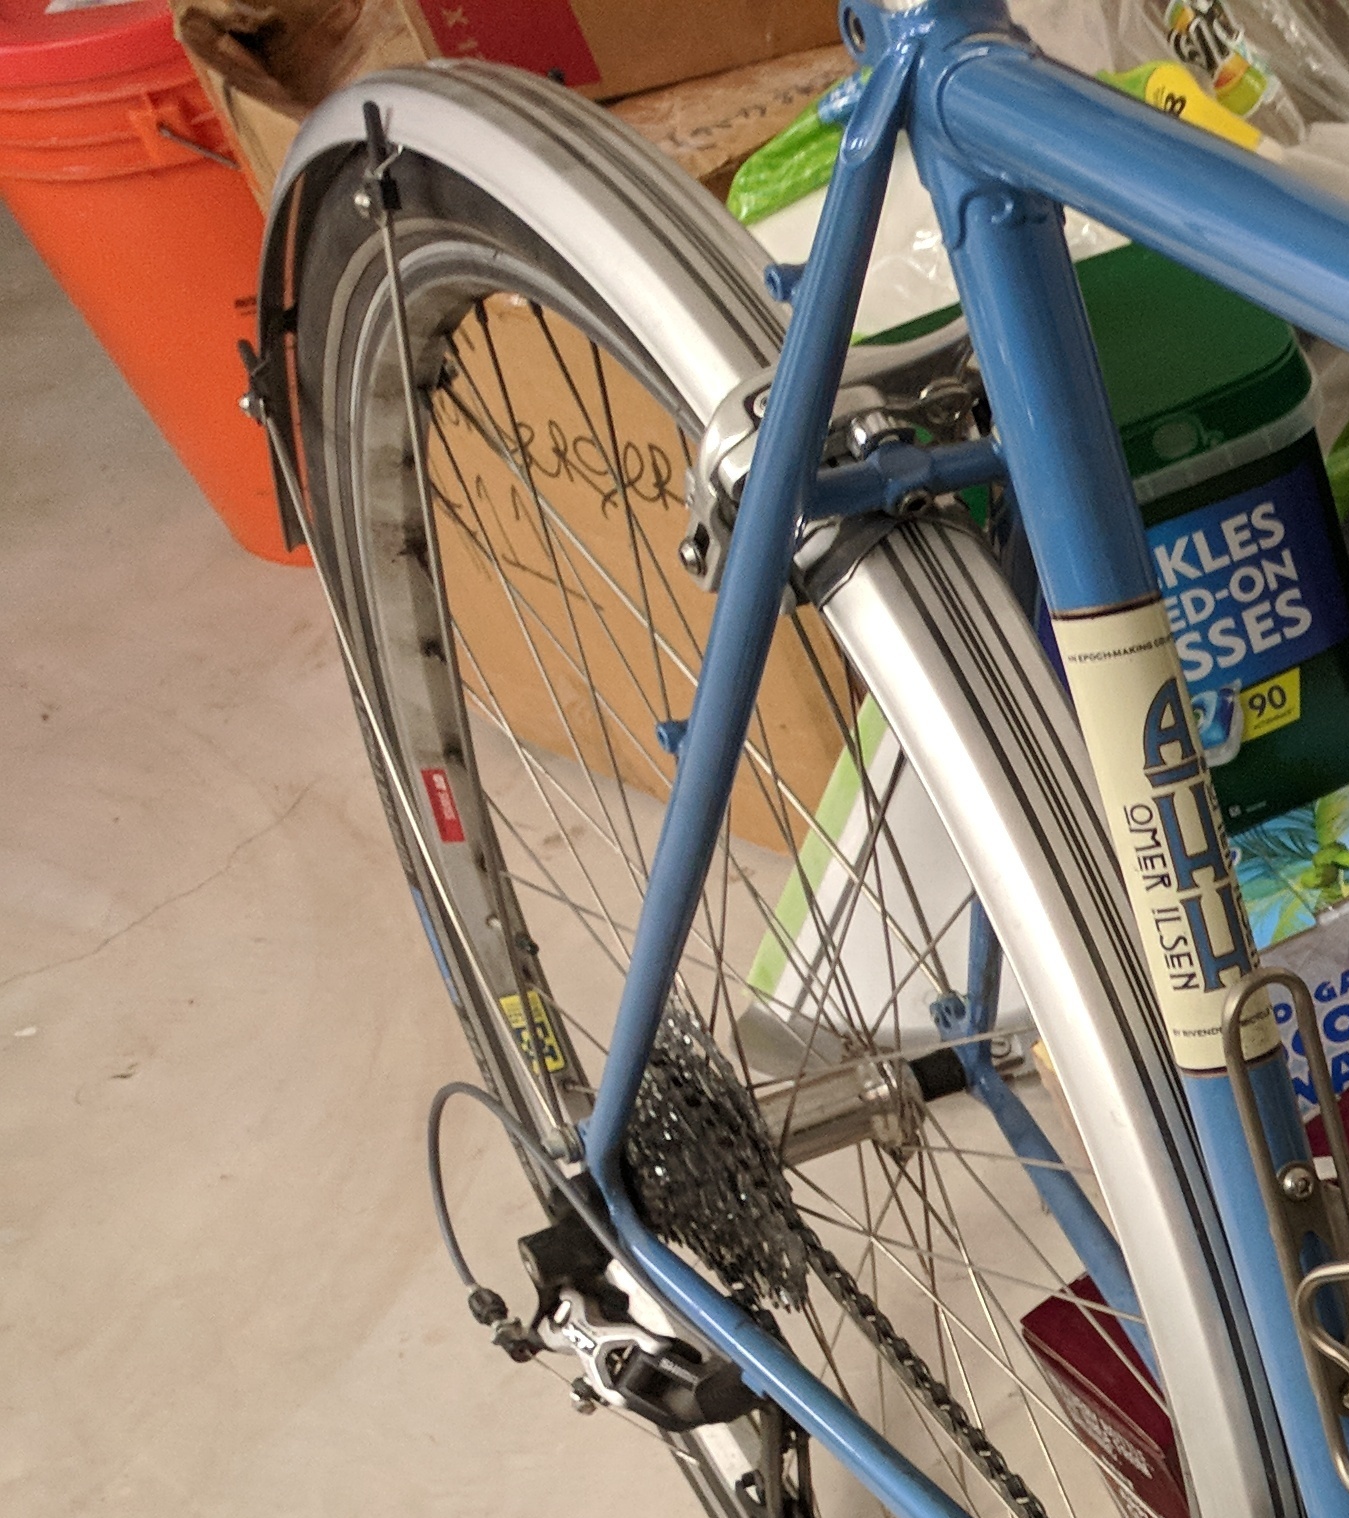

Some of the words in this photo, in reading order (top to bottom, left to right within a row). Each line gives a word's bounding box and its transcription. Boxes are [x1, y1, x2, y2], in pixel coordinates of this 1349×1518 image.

[1154, 502, 1285, 590] KLES
[1164, 549, 1299, 633] ED-ON
[1176, 588, 1313, 683] SSES
[1249, 684, 1287, 719] 90
[1123, 803, 1172, 892] OMER
[1151, 905, 1200, 993] ILSEN
